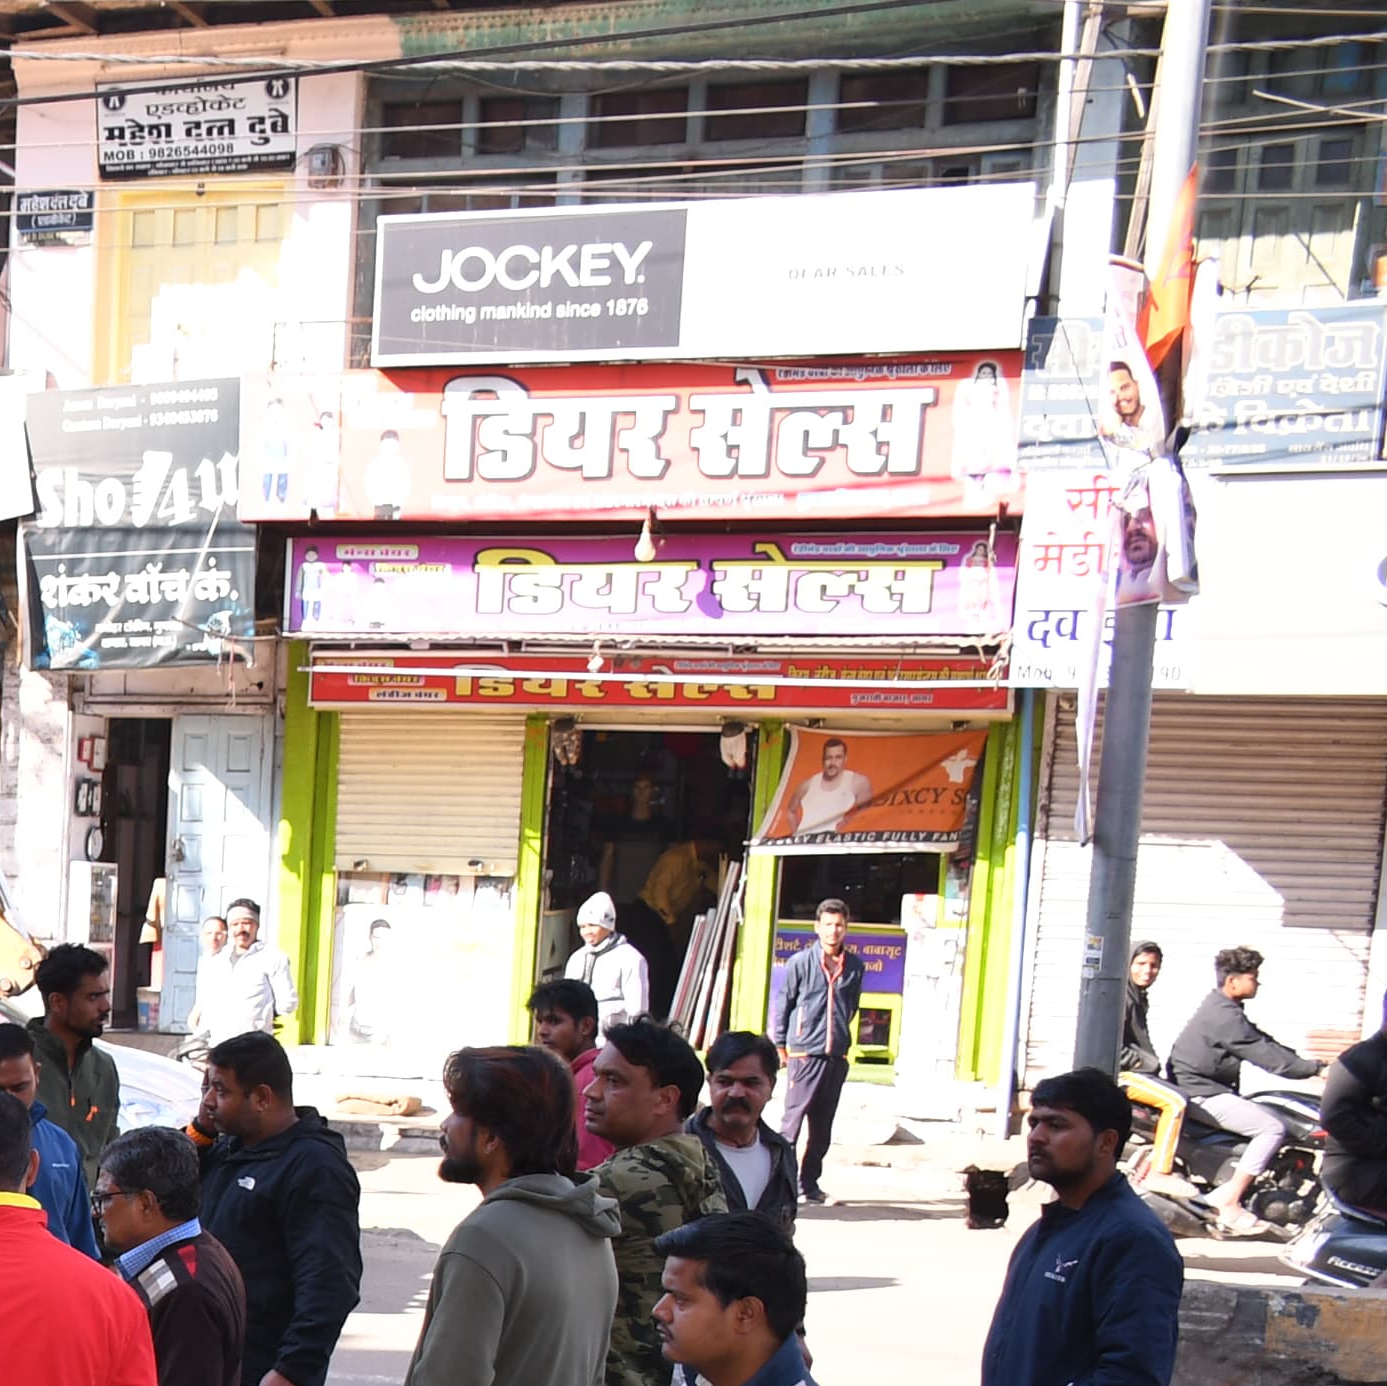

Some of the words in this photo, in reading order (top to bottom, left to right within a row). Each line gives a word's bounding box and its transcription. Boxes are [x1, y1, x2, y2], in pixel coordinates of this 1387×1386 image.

[104, 119, 172, 147] महेश
[247, 108, 290, 146] दुबे
[103, 149, 135, 162] MOB
[148, 143, 234, 160] 9826544098
[788, 265, 840, 279] DEAR
[844, 264, 906, 279] SALES
[411, 302, 476, 324] clothing
[479, 299, 552, 320] mankind
[556, 298, 601, 318] since
[605, 296, 649, 317] 1876
[1211, 312, 1381, 372] डीकोज
[440, 373, 681, 482] डियर
[687, 366, 939, 480] सेल्स
[40, 562, 121, 609] शंकर
[124, 560, 191, 604] वॉच
[193, 556, 239, 602] कं.
[473, 546, 699, 615] डियर
[711, 542, 945, 614] सेल्स
[454, 662, 607, 699] डियर
[815, 832, 877, 844] ELASTIC
[882, 831, 926, 842] FULLY
